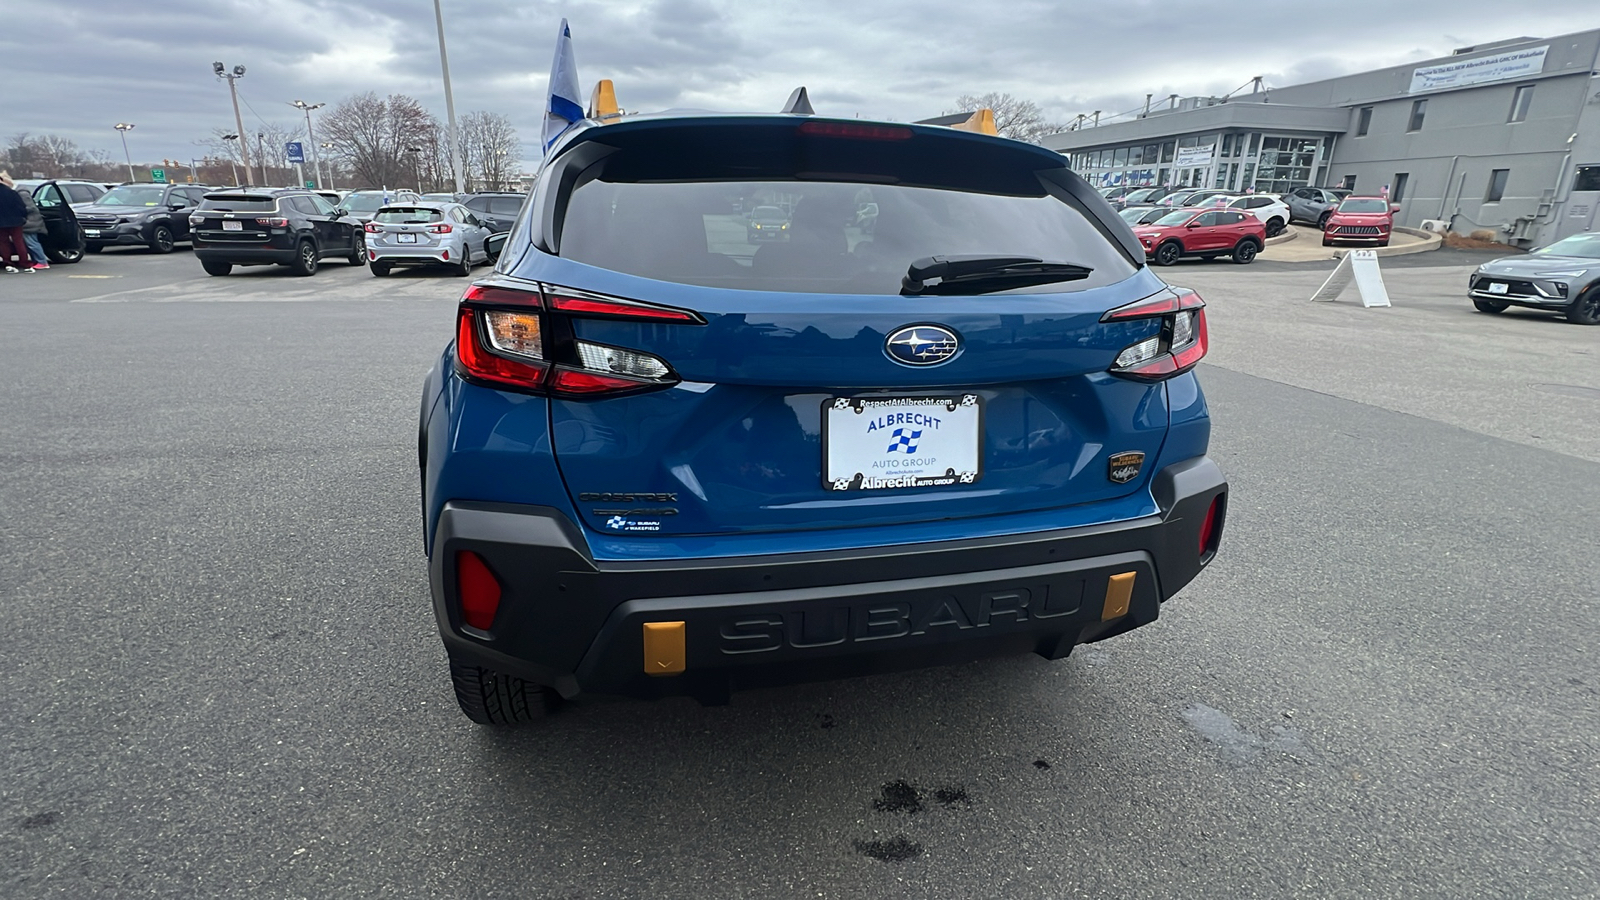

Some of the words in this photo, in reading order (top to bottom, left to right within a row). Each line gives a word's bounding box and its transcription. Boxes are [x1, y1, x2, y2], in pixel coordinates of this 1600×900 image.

[1466, 61, 1486, 69] Albrecht
[1519, 50, 1545, 59] Wakefield
[860, 398, 953, 408] RespectAtAlbrecht.com
[867, 413, 941, 433] ALBRECHT
[872, 459, 900, 469] AUTO
[902, 457, 937, 468] GROUP
[860, 475, 917, 490] Albrecht
[934, 478, 955, 486] GROUP
[579, 492, 678, 502] CROSSTREK
[719, 579, 1087, 655] SUBARU
